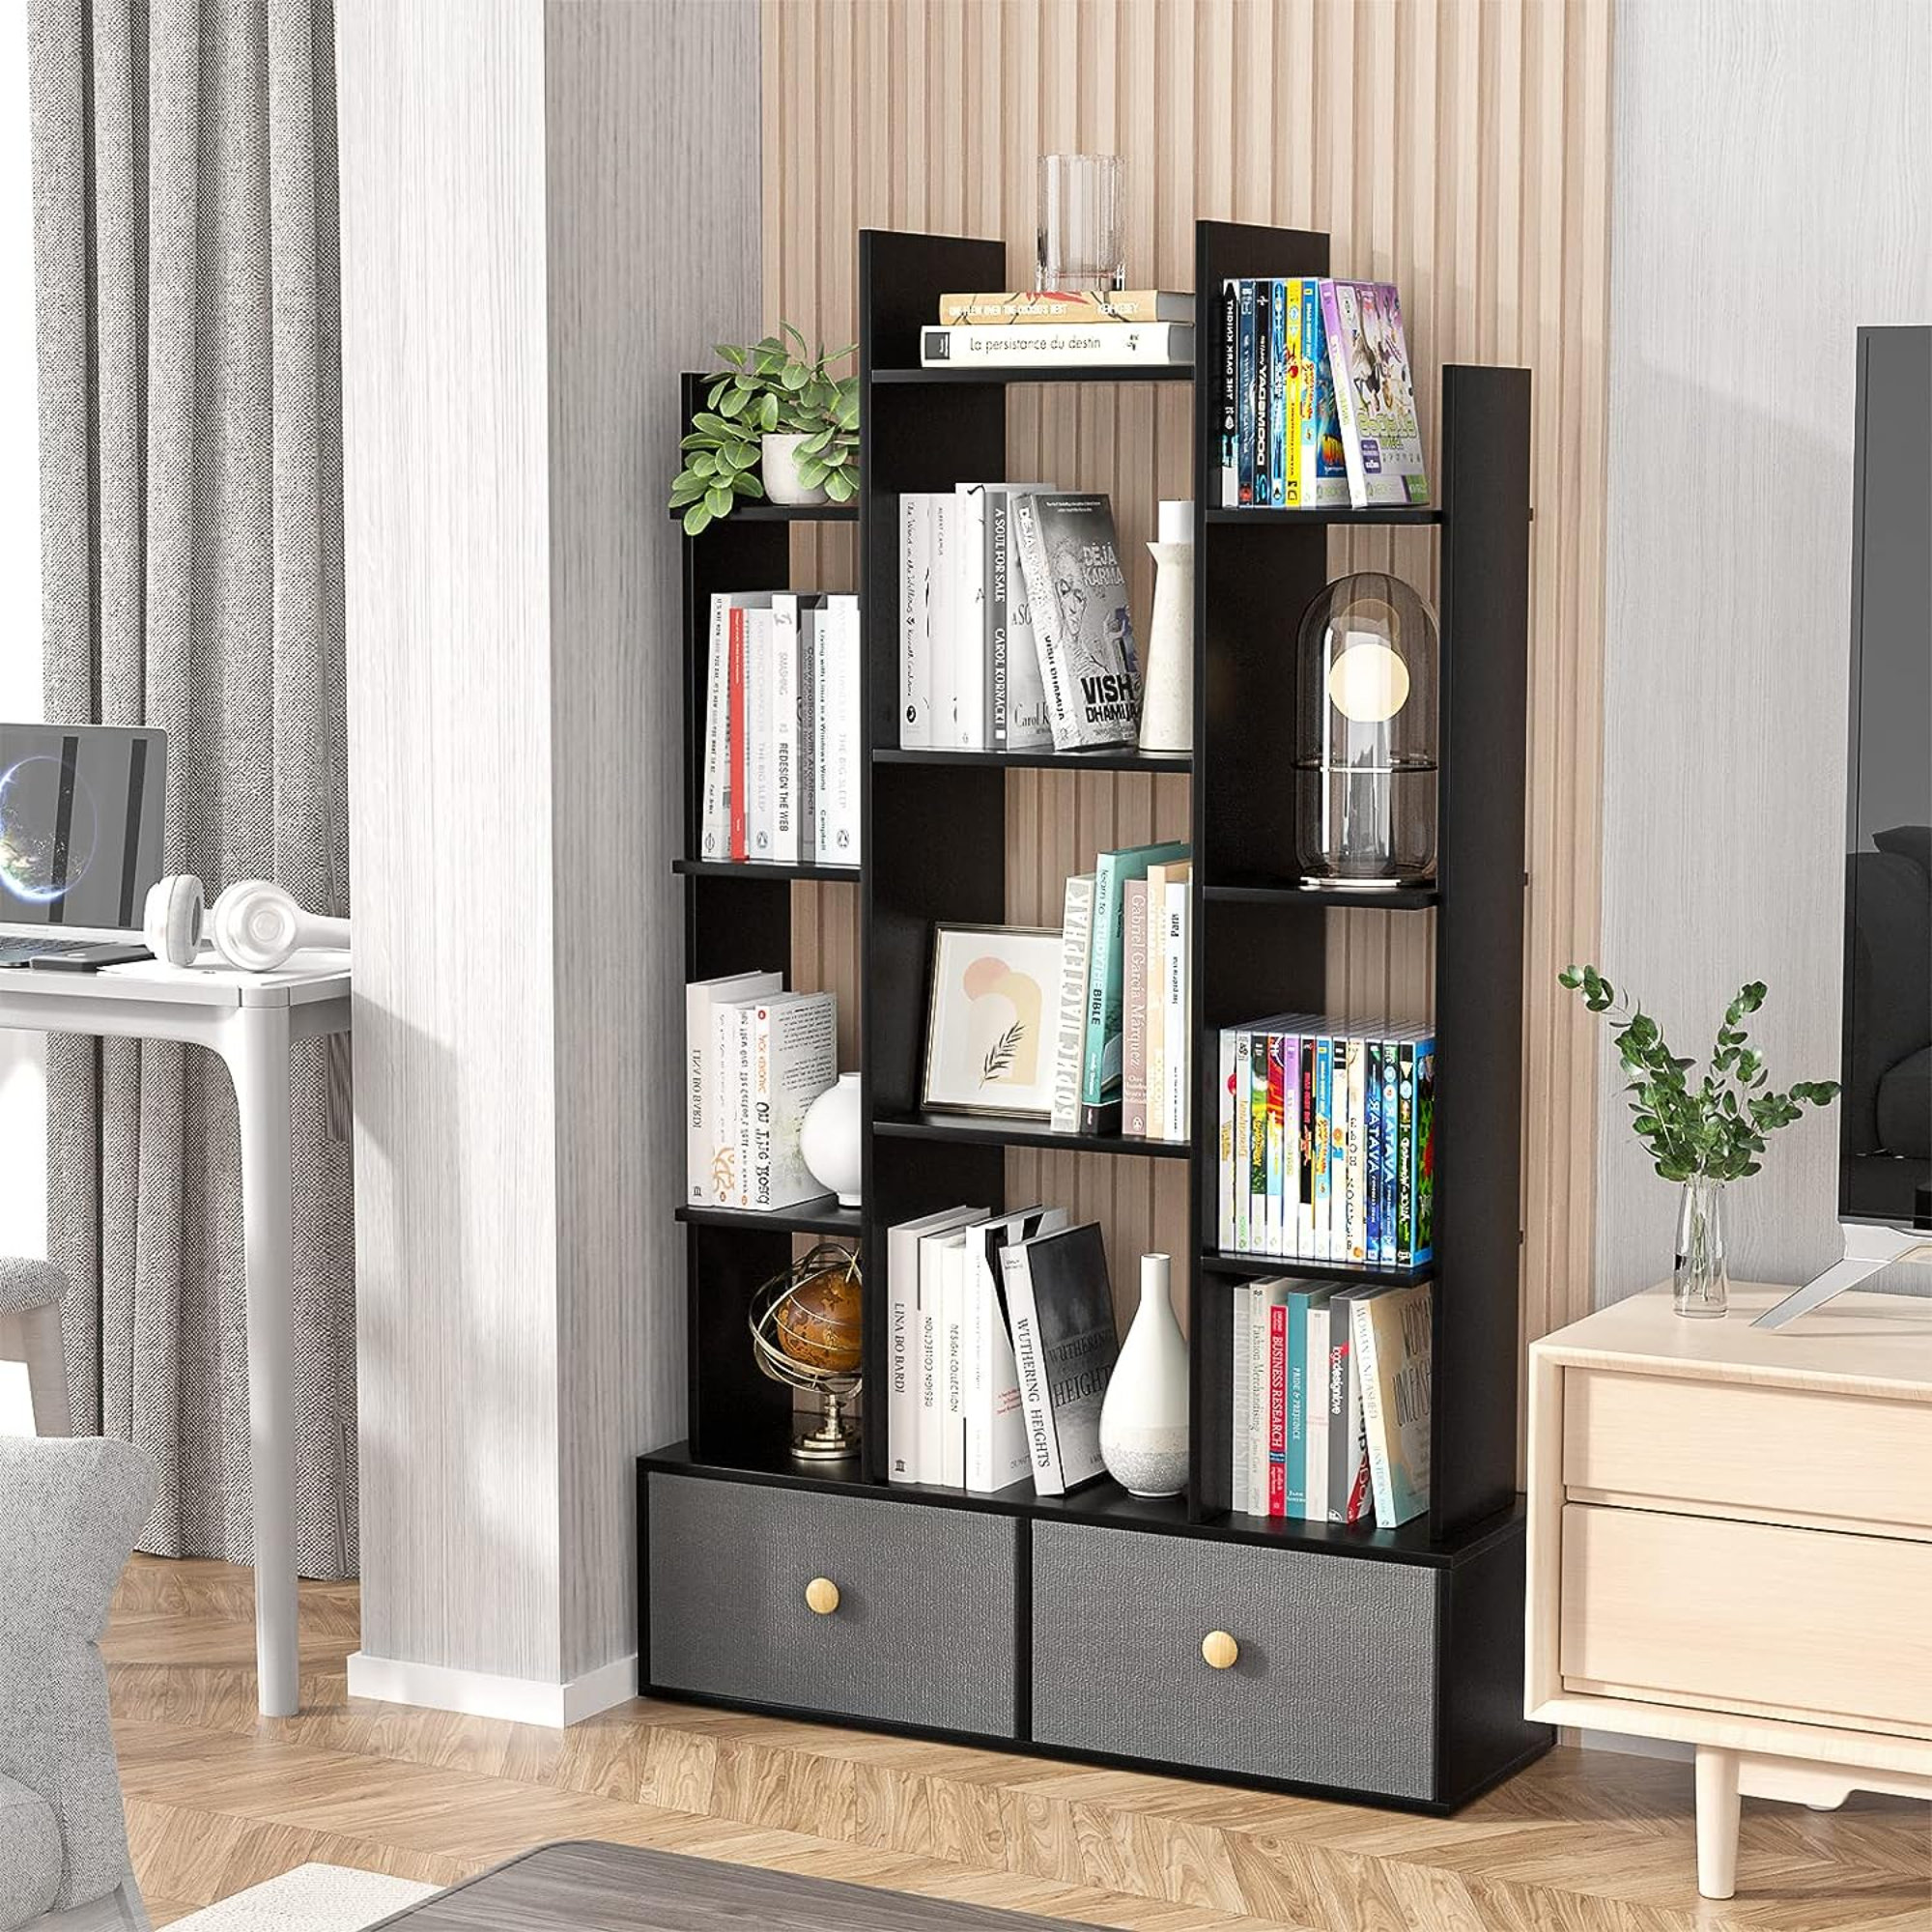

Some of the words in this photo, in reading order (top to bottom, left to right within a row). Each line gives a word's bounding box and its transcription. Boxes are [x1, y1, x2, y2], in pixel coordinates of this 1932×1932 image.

[970, 338, 982, 351] La
[985, 337, 1047, 354] persistance
[1050, 337, 1065, 350] du
[1068, 337, 1100, 350] destin
[995, 508, 1006, 519] A
[995, 520, 1006, 548] SOUL
[995, 551, 1006, 573] FOR
[995, 574, 1006, 602] SALE
[818, 629, 827, 656] Living
[995, 628, 1006, 666] CAROL
[1044, 636, 1056, 664] VISH
[995, 668, 1006, 724] KORNACKI
[1081, 675, 1134, 705] VISH
[1014, 702, 1040, 727] Carol
[757, 743, 766, 754] THE
[757, 757, 766, 775] BIG
[779, 743, 789, 788] REDESIGN
[757, 777, 766, 812] SLEEP
[779, 792, 789, 809] THE
[779, 810, 789, 832] WEB
[818, 810, 827, 850] Campbell
[1097, 869, 1110, 899] learn
[1097, 902, 1107, 915] to
[1130, 895, 1146, 947] Gabriel
[1170, 914, 1179, 937] Paris
[1130, 952, 1146, 997] García
[1091, 989, 1103, 1025] BIBLE
[1128, 1004, 1146, 1066] Márquez
[894, 1303, 905, 1331] LINA
[1399, 1296, 1431, 1359] WOMA
[894, 1335, 905, 1352] BO
[1253, 1324, 1264, 1359] Fashion
[894, 1355, 905, 1393] BARDI
[1271, 1336, 1284, 1388] BUSINESS
[1293, 1367, 1301, 1390] PRIDE
[1016, 1319, 1039, 1402] WUTHERING
[1030, 1409, 1050, 1468] HEIGHTS
[1053, 1365, 1111, 1408] HEIGHT
[1250, 1362, 1264, 1432] Merchandising
[1331, 1347, 1344, 1414] logodesignlove
[1393, 1359, 1431, 1426] UNLEASH
[1271, 1390, 1284, 1447] RESEARCH
[1292, 1399, 1301, 1439] PREJUDICE
